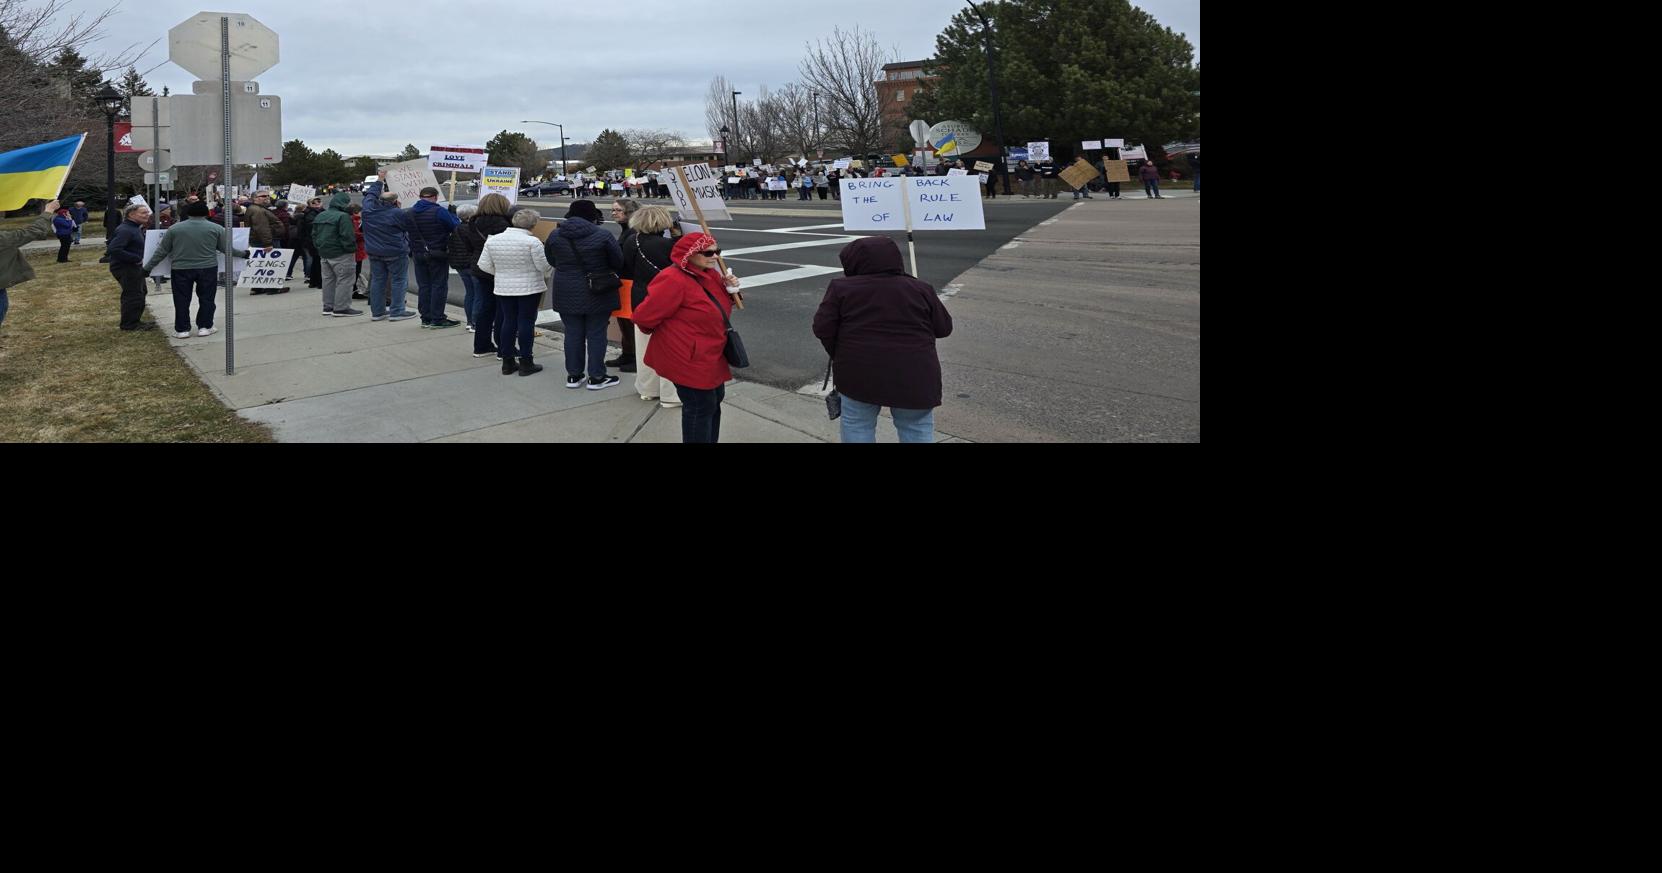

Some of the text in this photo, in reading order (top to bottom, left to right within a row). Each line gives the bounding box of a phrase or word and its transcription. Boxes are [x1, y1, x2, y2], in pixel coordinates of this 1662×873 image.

[683, 164, 710, 182] ELON
[848, 181, 894, 190] BRING
[691, 185, 720, 199] MUSK
[920, 194, 962, 202] RULE
[871, 213, 954, 222] OF LAW
[252, 249, 281, 258] NO
